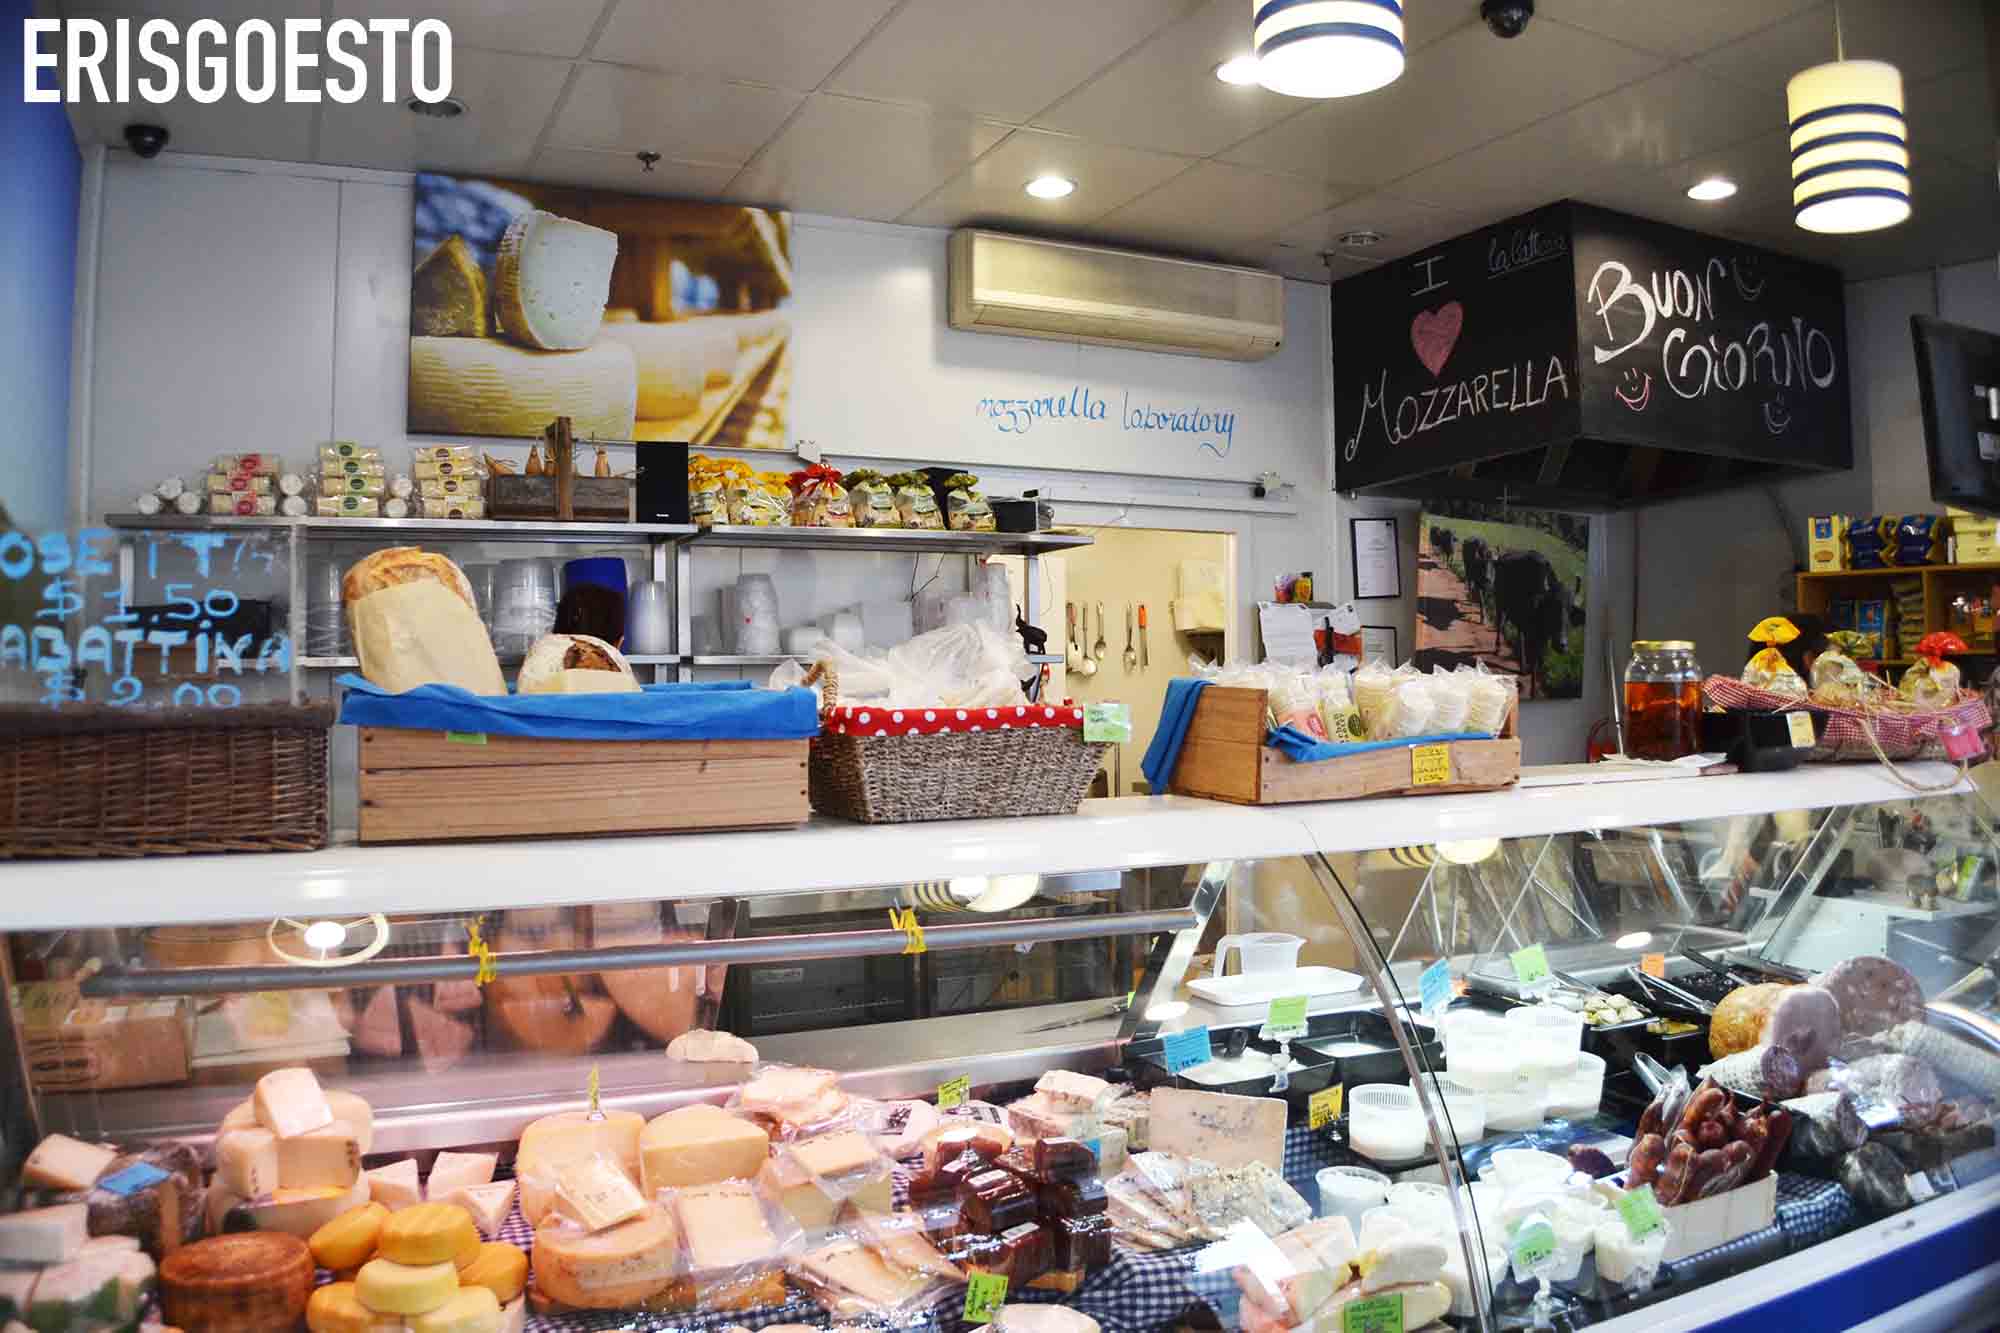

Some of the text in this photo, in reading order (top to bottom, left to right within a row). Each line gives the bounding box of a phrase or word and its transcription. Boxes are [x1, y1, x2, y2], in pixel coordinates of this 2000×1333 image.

[1411, 255, 1449, 297] I
[1120, 391, 1236, 458] laboratory
[1345, 354, 1569, 462] MOZZARELLA
